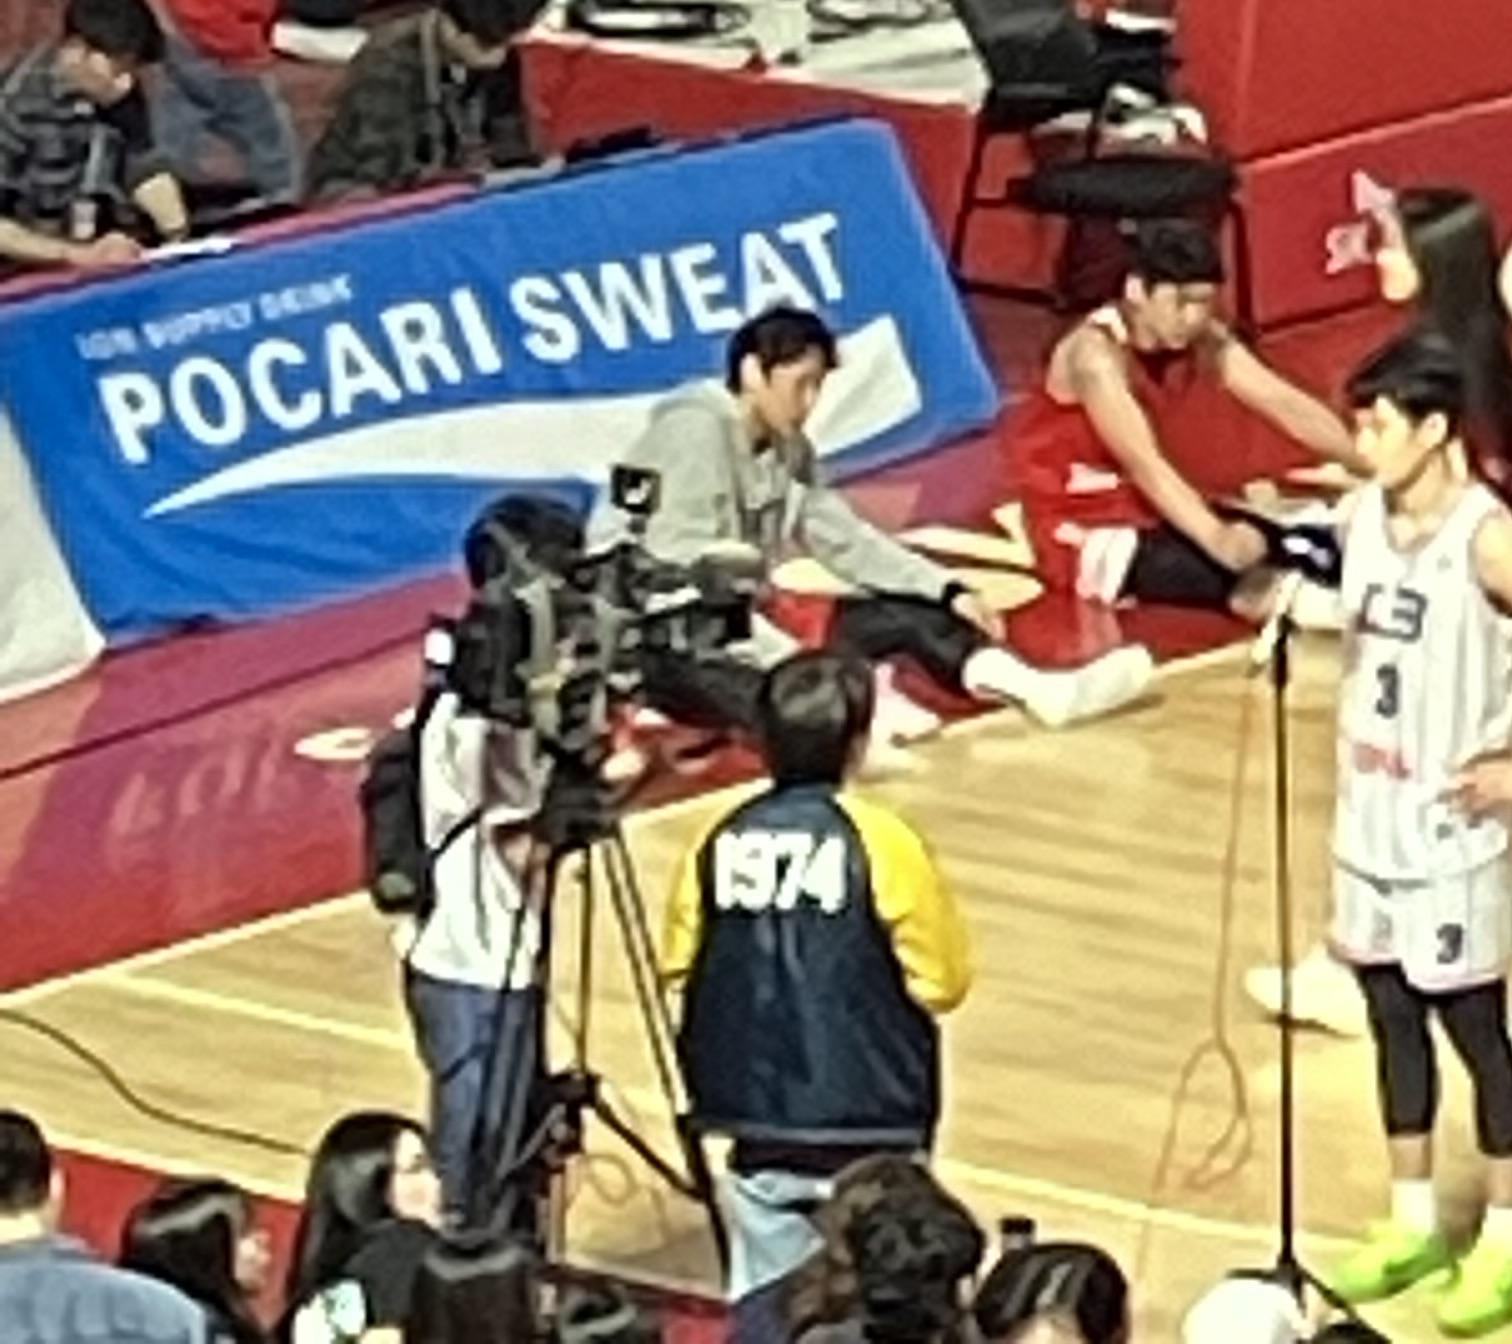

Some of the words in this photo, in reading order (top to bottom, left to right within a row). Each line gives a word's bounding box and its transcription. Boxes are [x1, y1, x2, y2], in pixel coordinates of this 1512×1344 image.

[97, 287, 502, 465] POCARI
[509, 212, 846, 365] SWEAT
[715, 831, 847, 915] 1974
